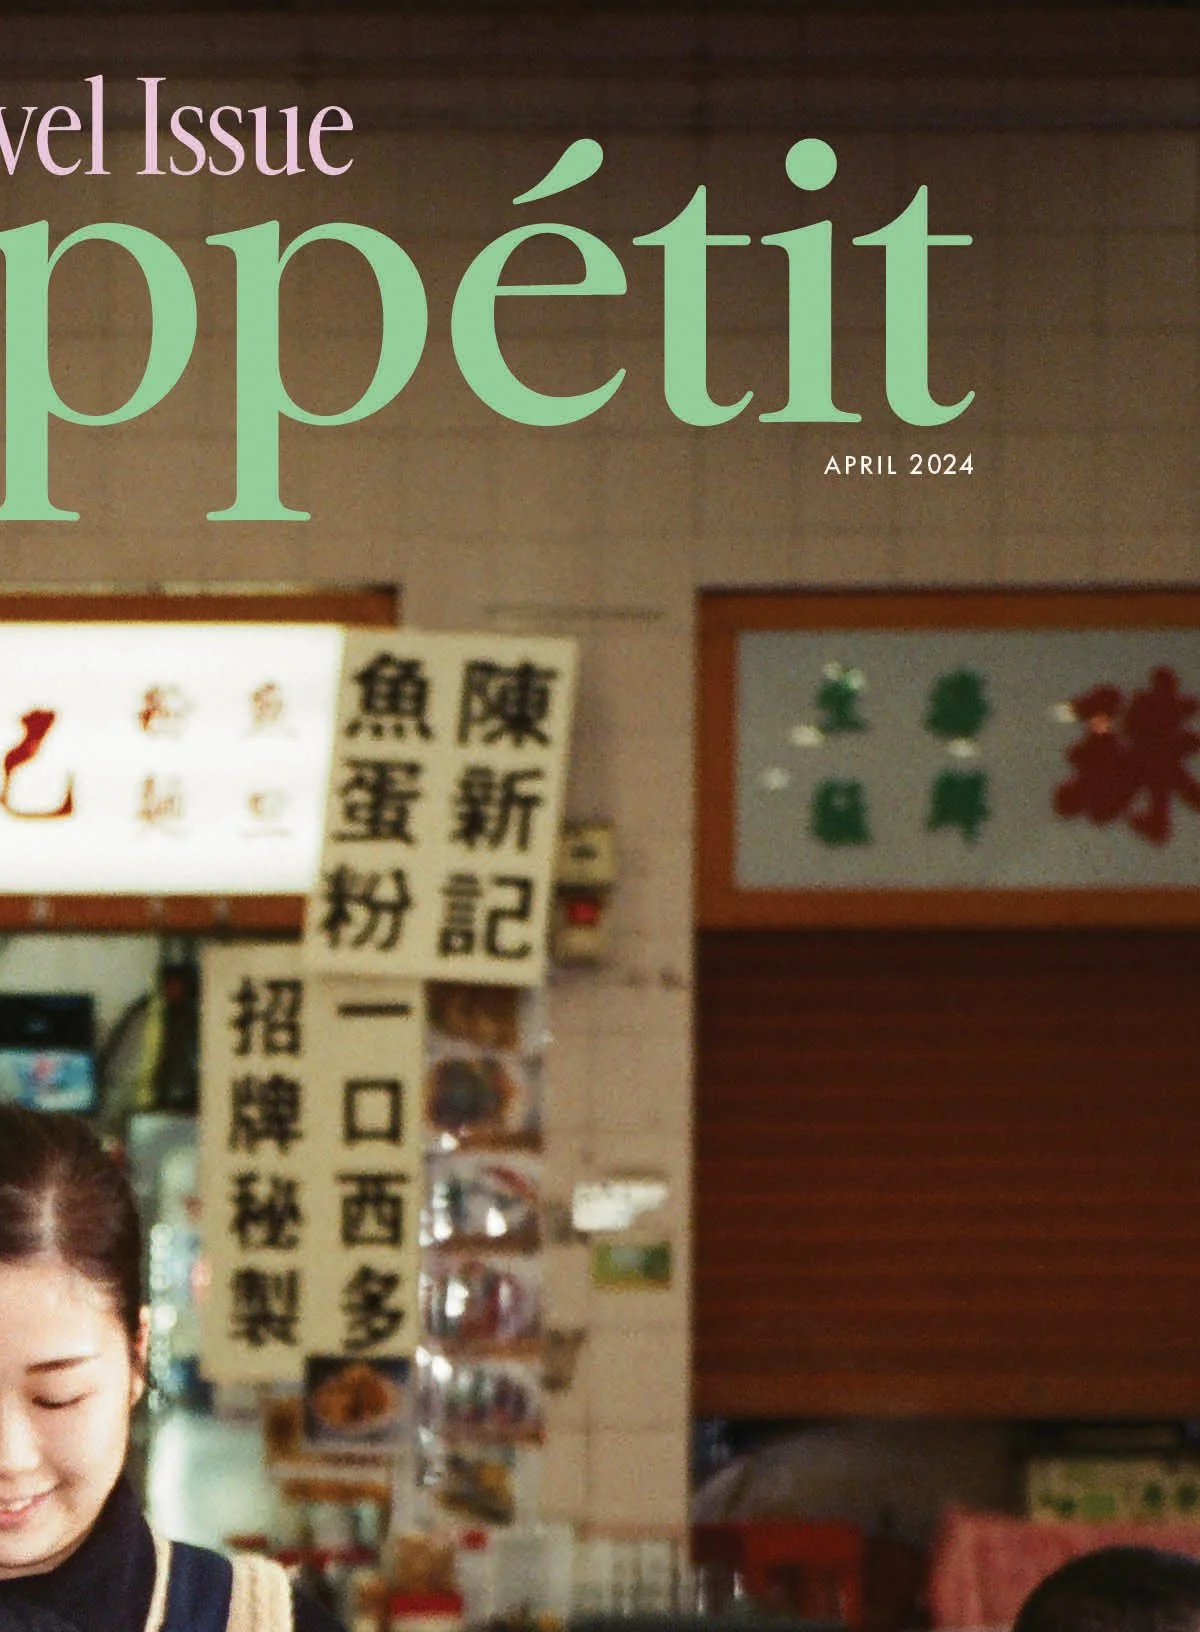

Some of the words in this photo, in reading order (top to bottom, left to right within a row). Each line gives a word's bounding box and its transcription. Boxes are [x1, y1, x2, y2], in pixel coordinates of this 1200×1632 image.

[318, 650, 434, 954] 魚蛋粉
[438, 658, 561, 962] 陳新記
[226, 975, 305, 1350] 招牌秘製
[335, 1000, 411, 1356] 一口西多
